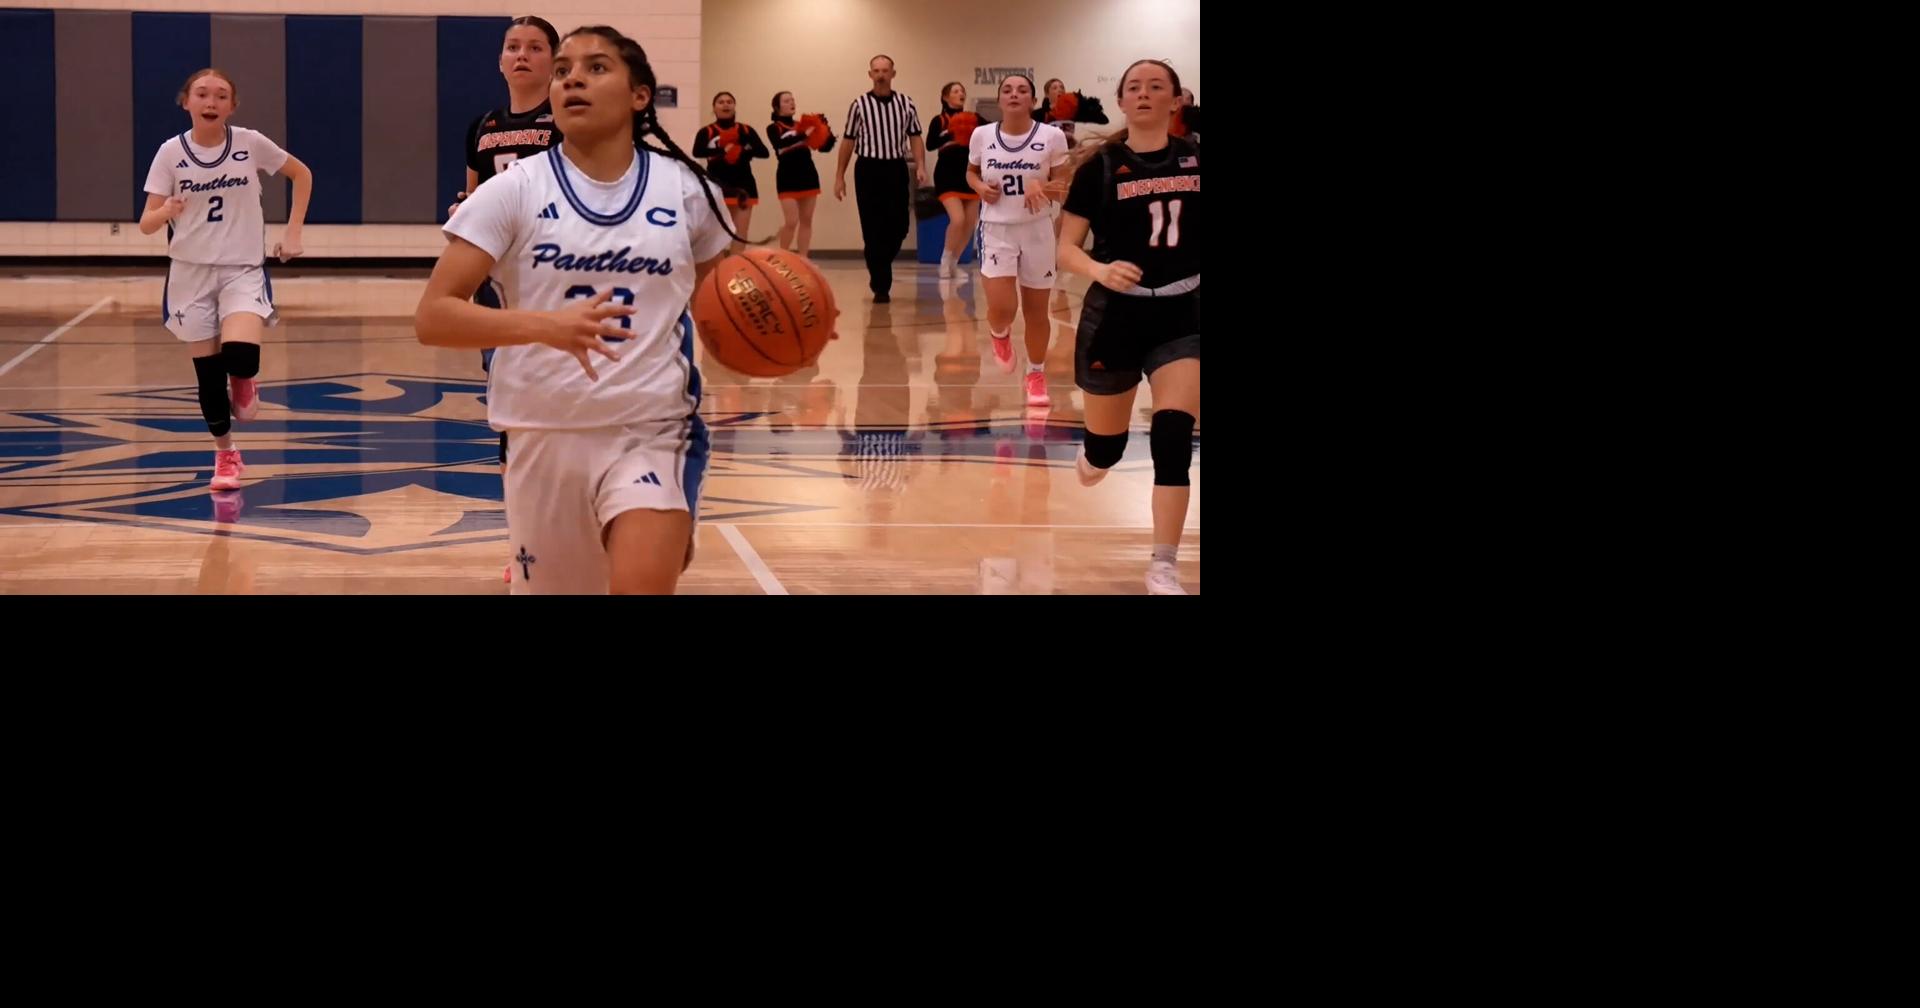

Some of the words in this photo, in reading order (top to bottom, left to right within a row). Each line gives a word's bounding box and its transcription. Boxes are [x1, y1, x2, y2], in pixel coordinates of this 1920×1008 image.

[232, 151, 249, 161] C
[1030, 143, 1045, 151] C
[987, 159, 1041, 171] Panthers
[179, 174, 249, 193] Panthers
[1002, 175, 1025, 196] 21
[207, 195, 223, 222] 2
[645, 206, 678, 227] C
[1148, 199, 1182, 247] 11
[532, 243, 674, 276] Panthers
